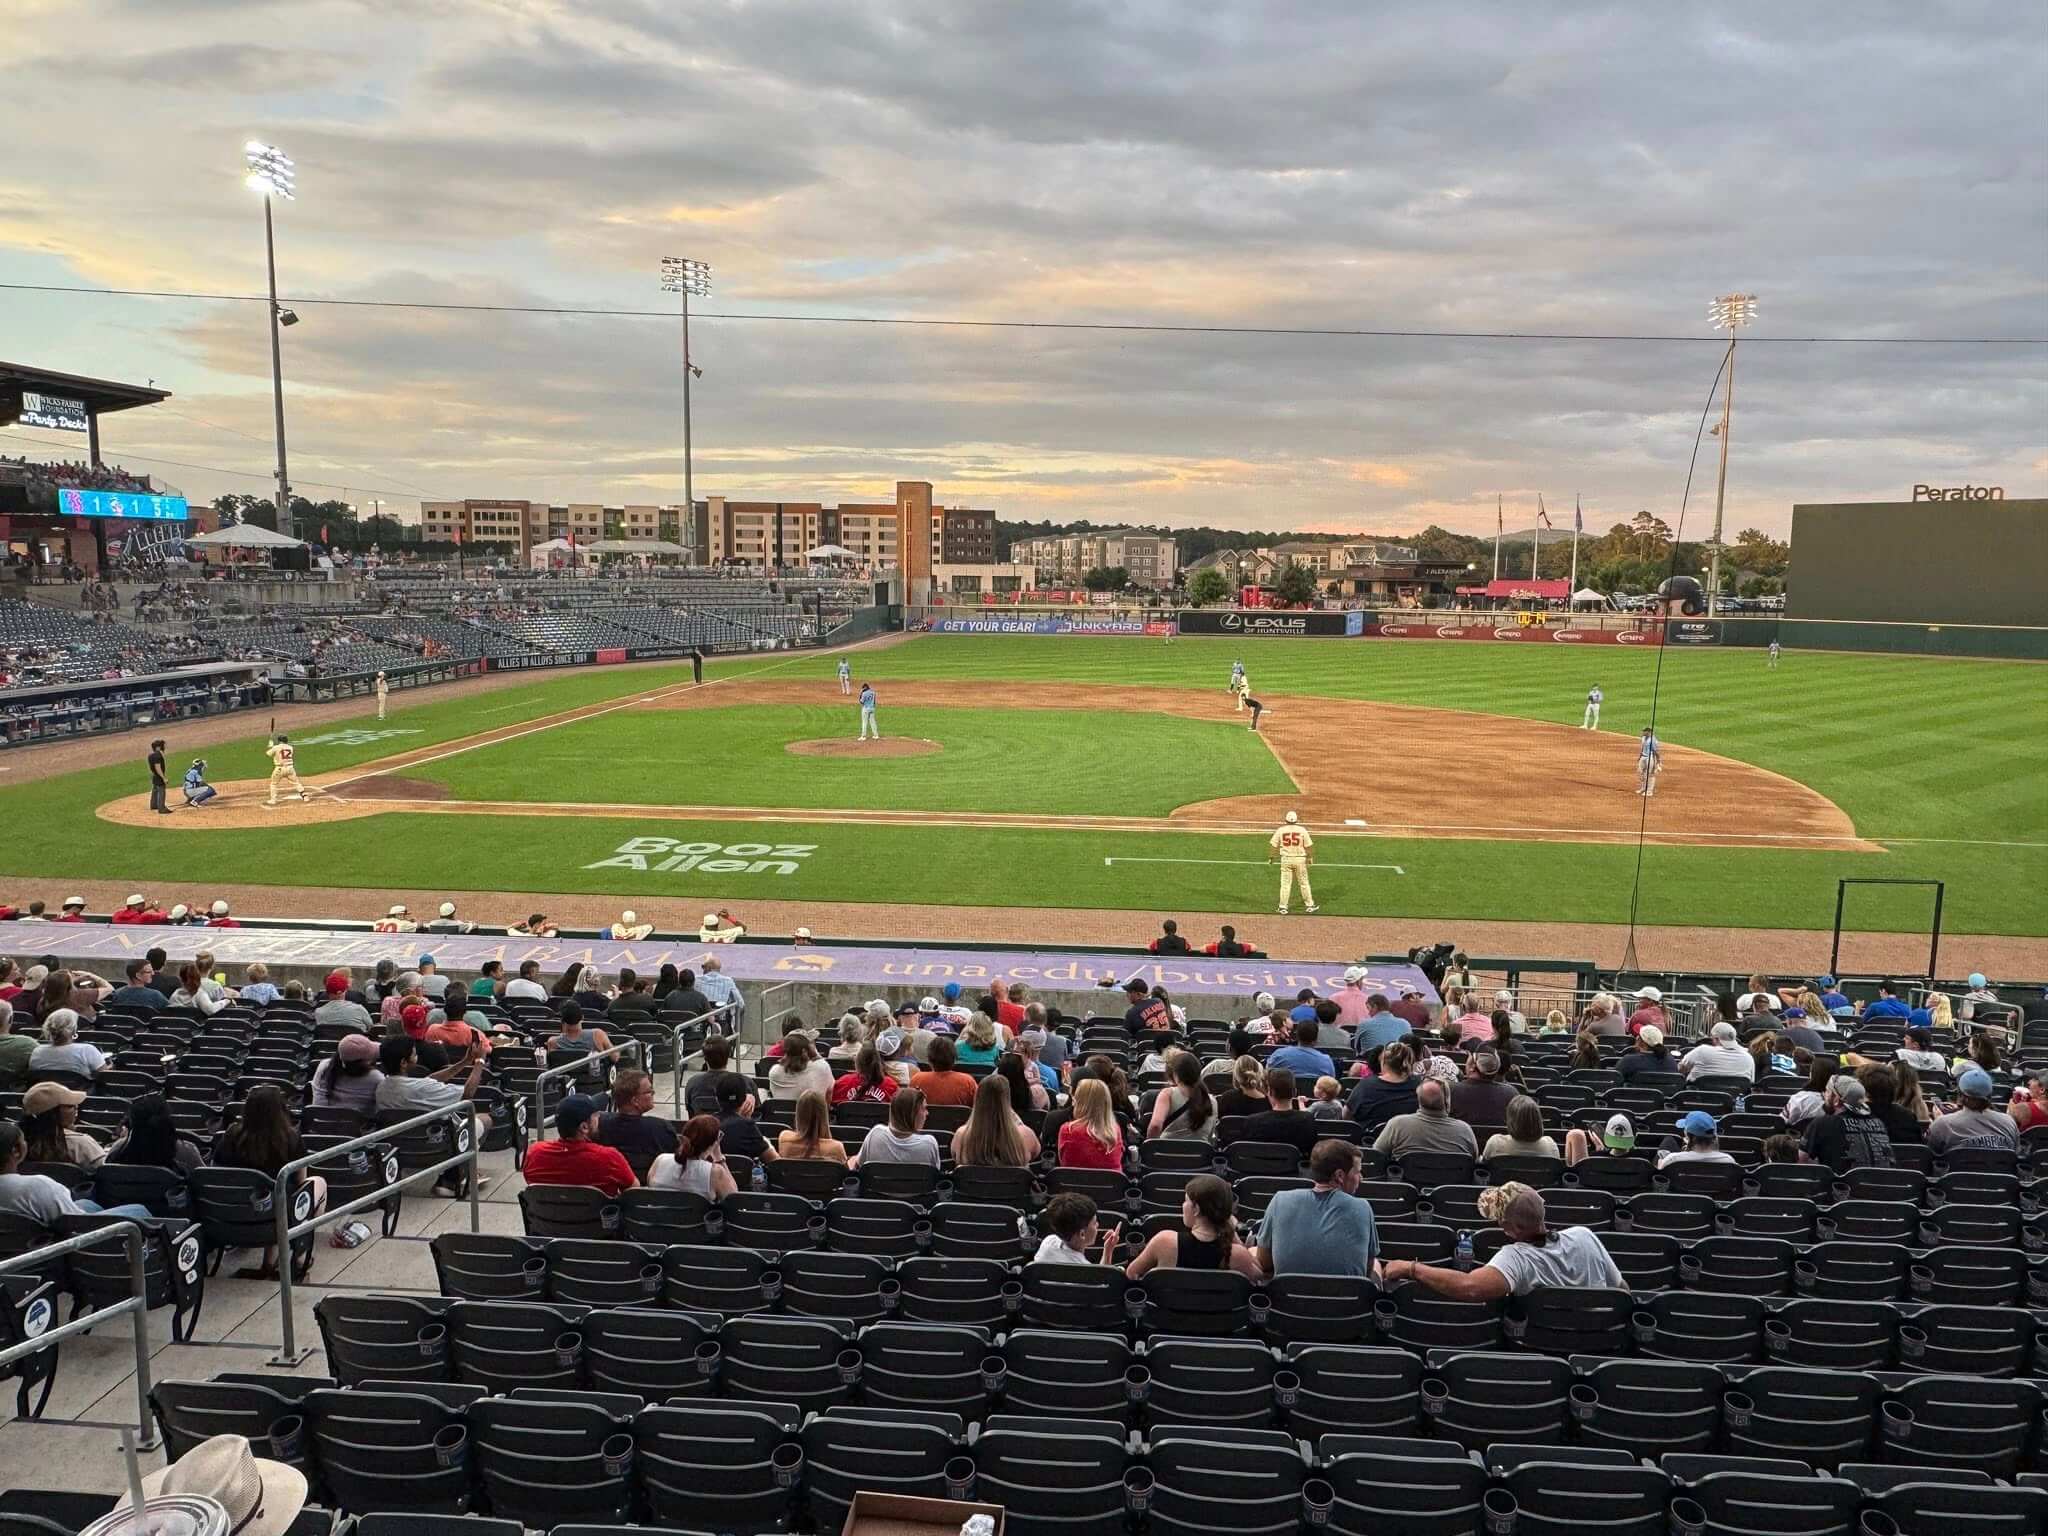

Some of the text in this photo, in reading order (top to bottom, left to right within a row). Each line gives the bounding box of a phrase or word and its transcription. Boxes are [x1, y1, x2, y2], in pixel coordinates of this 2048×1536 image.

[1913, 484, 2004, 503] Peraton
[943, 621, 967, 632] GET
[969, 621, 999, 632] YOUR
[1002, 621, 1036, 633] GEAR!
[1065, 622, 1142, 632] JUNKYARD
[1244, 618, 1306, 627] LEXUS
[498, 657, 520, 669] ALLIES
[521, 657, 529, 667] IN
[530, 655, 553, 666] ALLOYS
[554, 655, 572, 664] SINCE
[280, 749, 291, 760] 12
[1282, 833, 1301, 846] 55
[615, 837, 819, 857] Booz
[578, 854, 800, 875] Allen
[882, 961, 1416, 992] una.edu/business
